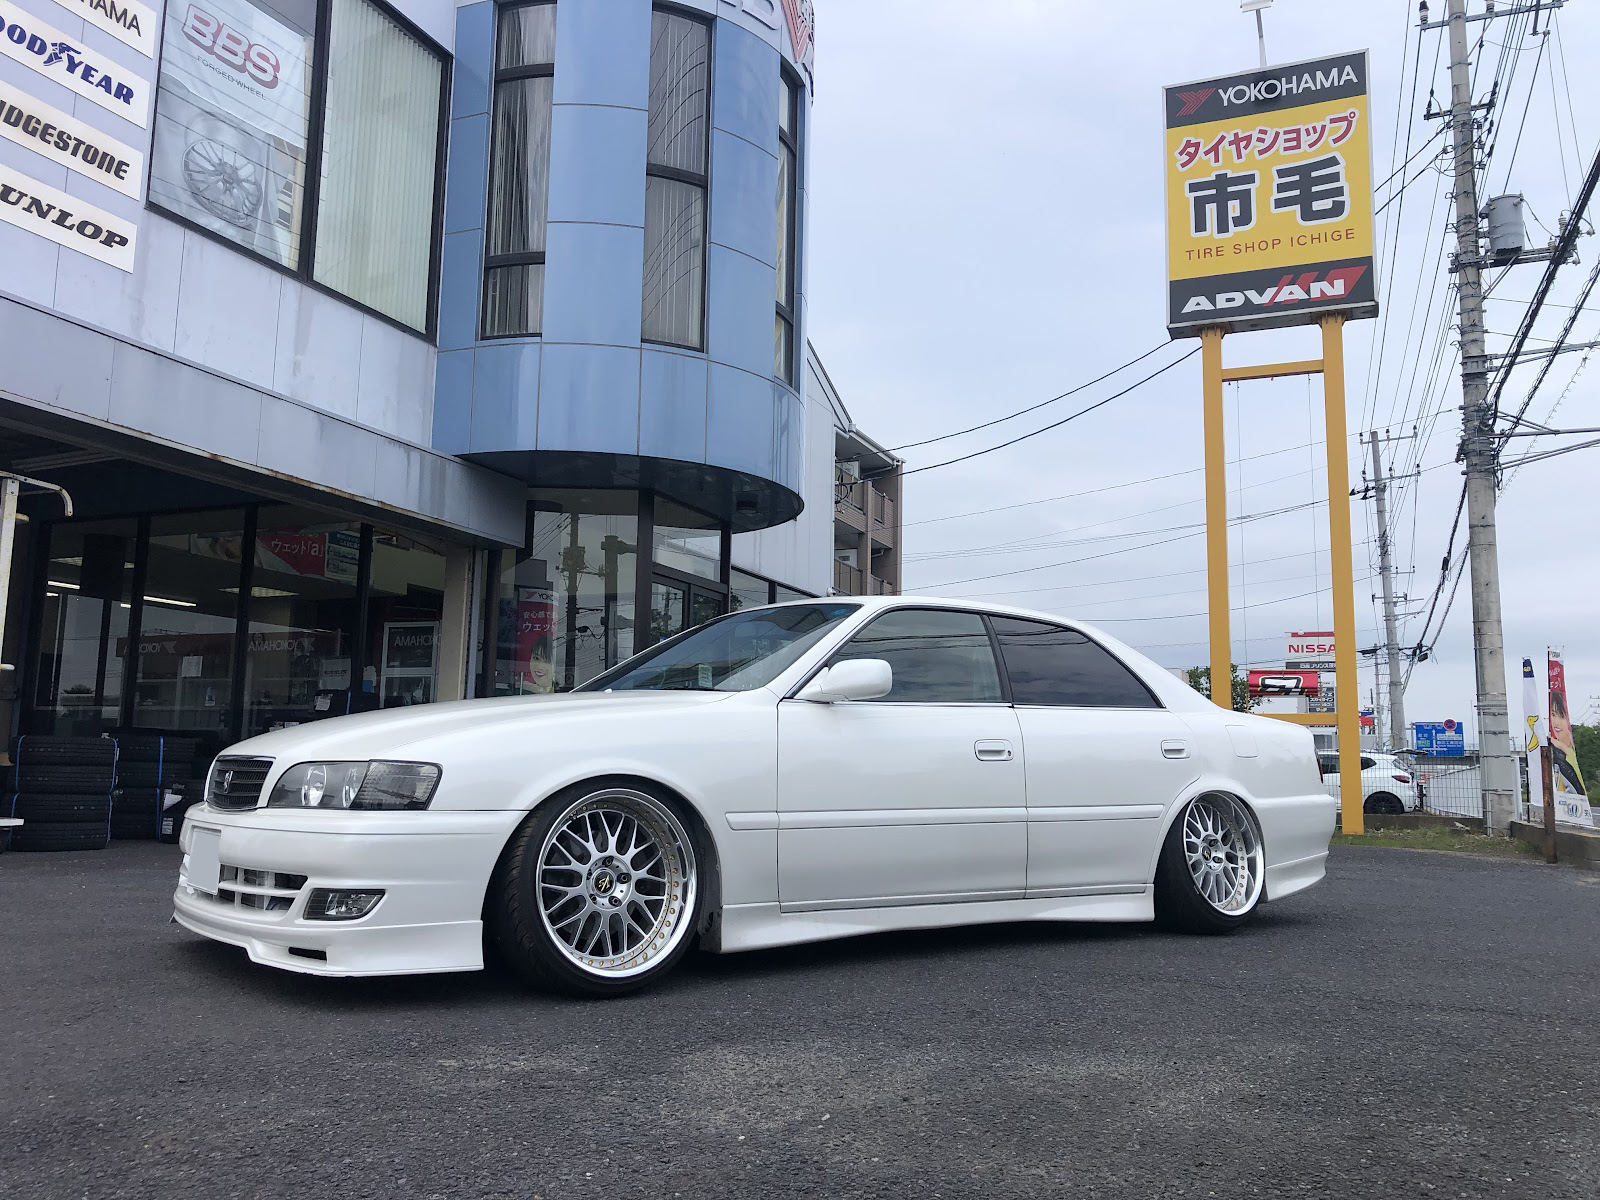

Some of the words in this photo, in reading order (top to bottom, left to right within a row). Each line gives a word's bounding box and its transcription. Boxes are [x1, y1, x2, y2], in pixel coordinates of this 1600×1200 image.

[181, 3, 280, 90] BBS
[197, 55, 235, 83] FORGED
[234, 78, 266, 101] WHEEL
[1218, 64, 1358, 107] YOKOHAMA
[1177, 110, 1357, 170] タイヤショップ
[1187, 155, 1346, 235] 市毛
[1185, 246, 1225, 261] TIRE
[1233, 238, 1281, 254] SHOP
[1290, 227, 1356, 247] ICHIGE
[1181, 278, 1345, 314] ADVAN
